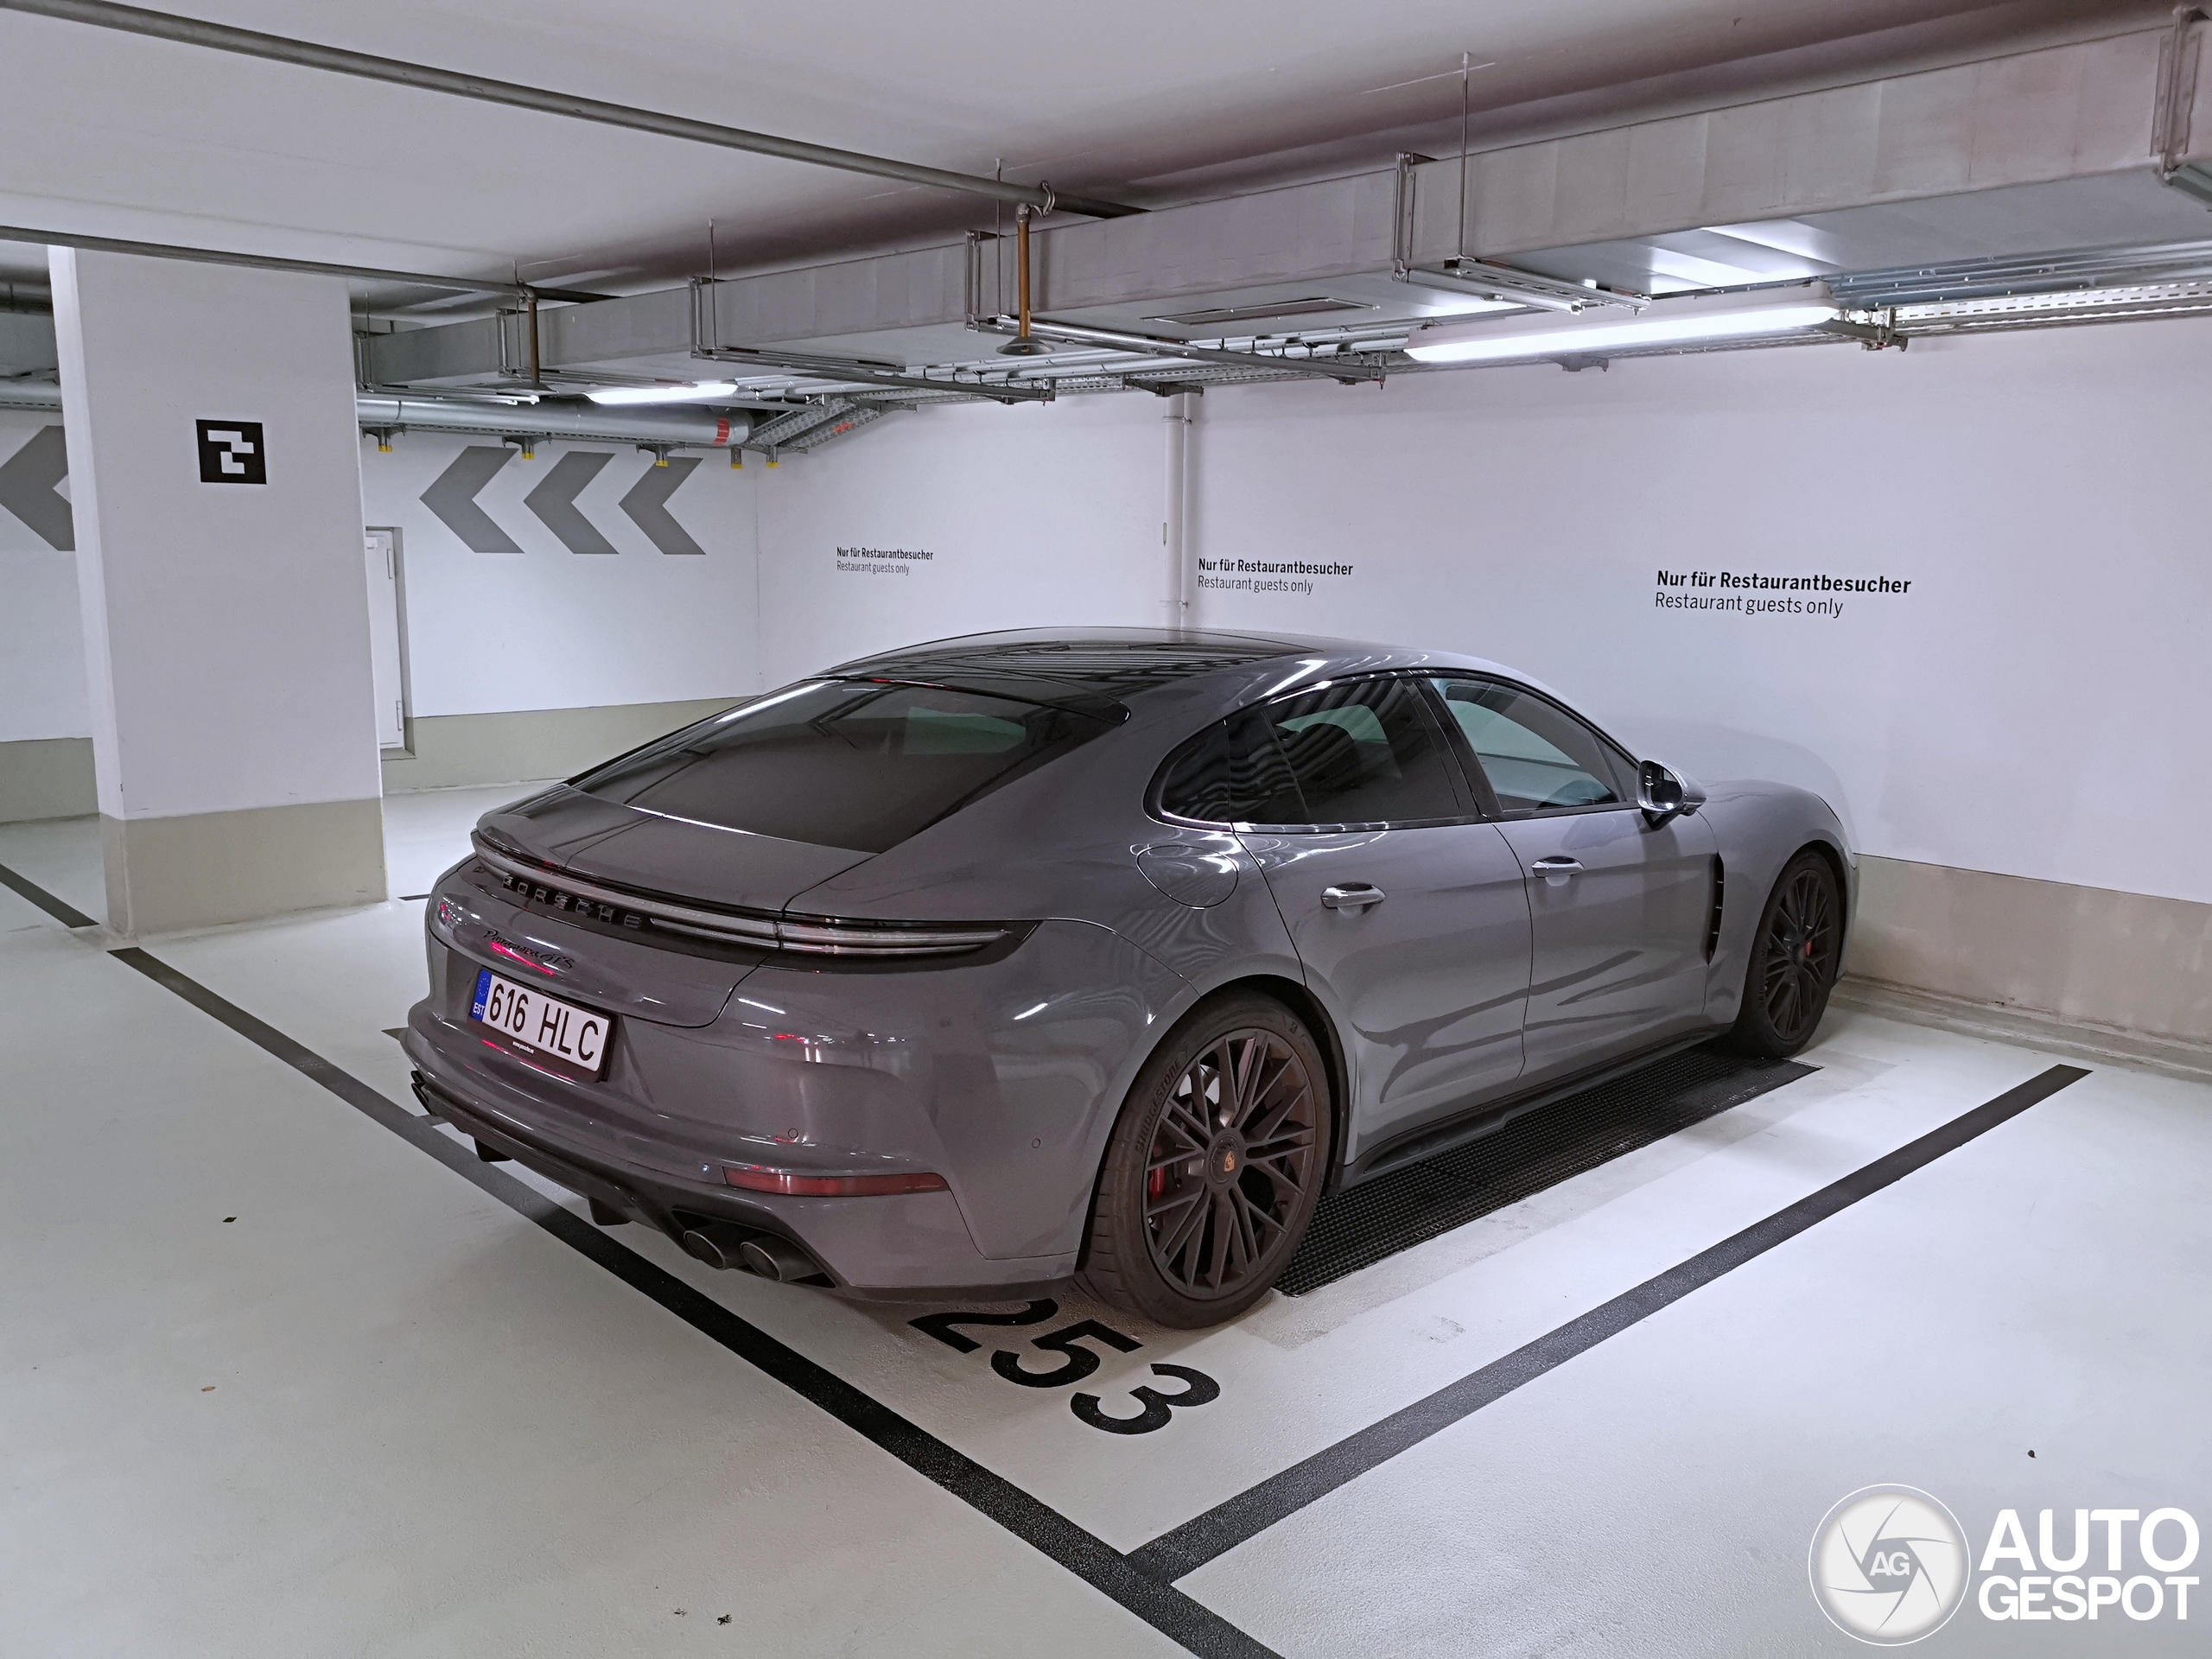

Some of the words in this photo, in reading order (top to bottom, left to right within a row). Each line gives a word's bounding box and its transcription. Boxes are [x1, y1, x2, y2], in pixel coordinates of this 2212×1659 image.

[836, 546, 849, 557] Nur
[850, 547, 861, 558] für
[861, 548, 934, 560] Restaurantbesucher
[836, 560, 872, 573] Restaurant
[873, 563, 894, 575] guests
[895, 563, 910, 575] only
[1198, 558, 1217, 571] Nur
[1219, 558, 1236, 572] für
[1237, 559, 1354, 575] Restaurantbesucher
[1198, 575, 1252, 590] Restaurant
[1253, 578, 1288, 593] guests
[1290, 579, 1313, 595] only
[1656, 570, 1687, 587] Nur
[1691, 571, 1716, 588] für
[1719, 572, 1912, 594] Restaurantbesucher
[1655, 592, 1742, 611] Restaurant
[1745, 595, 1802, 615] guests
[1806, 597, 1844, 619] only
[501, 874, 642, 929] PORSCHE
[473, 1002, 485, 1015] EST
[489, 983, 529, 1033] 616
[537, 1002, 599, 1061] HLC
[906, 1298, 1221, 1435] 253
